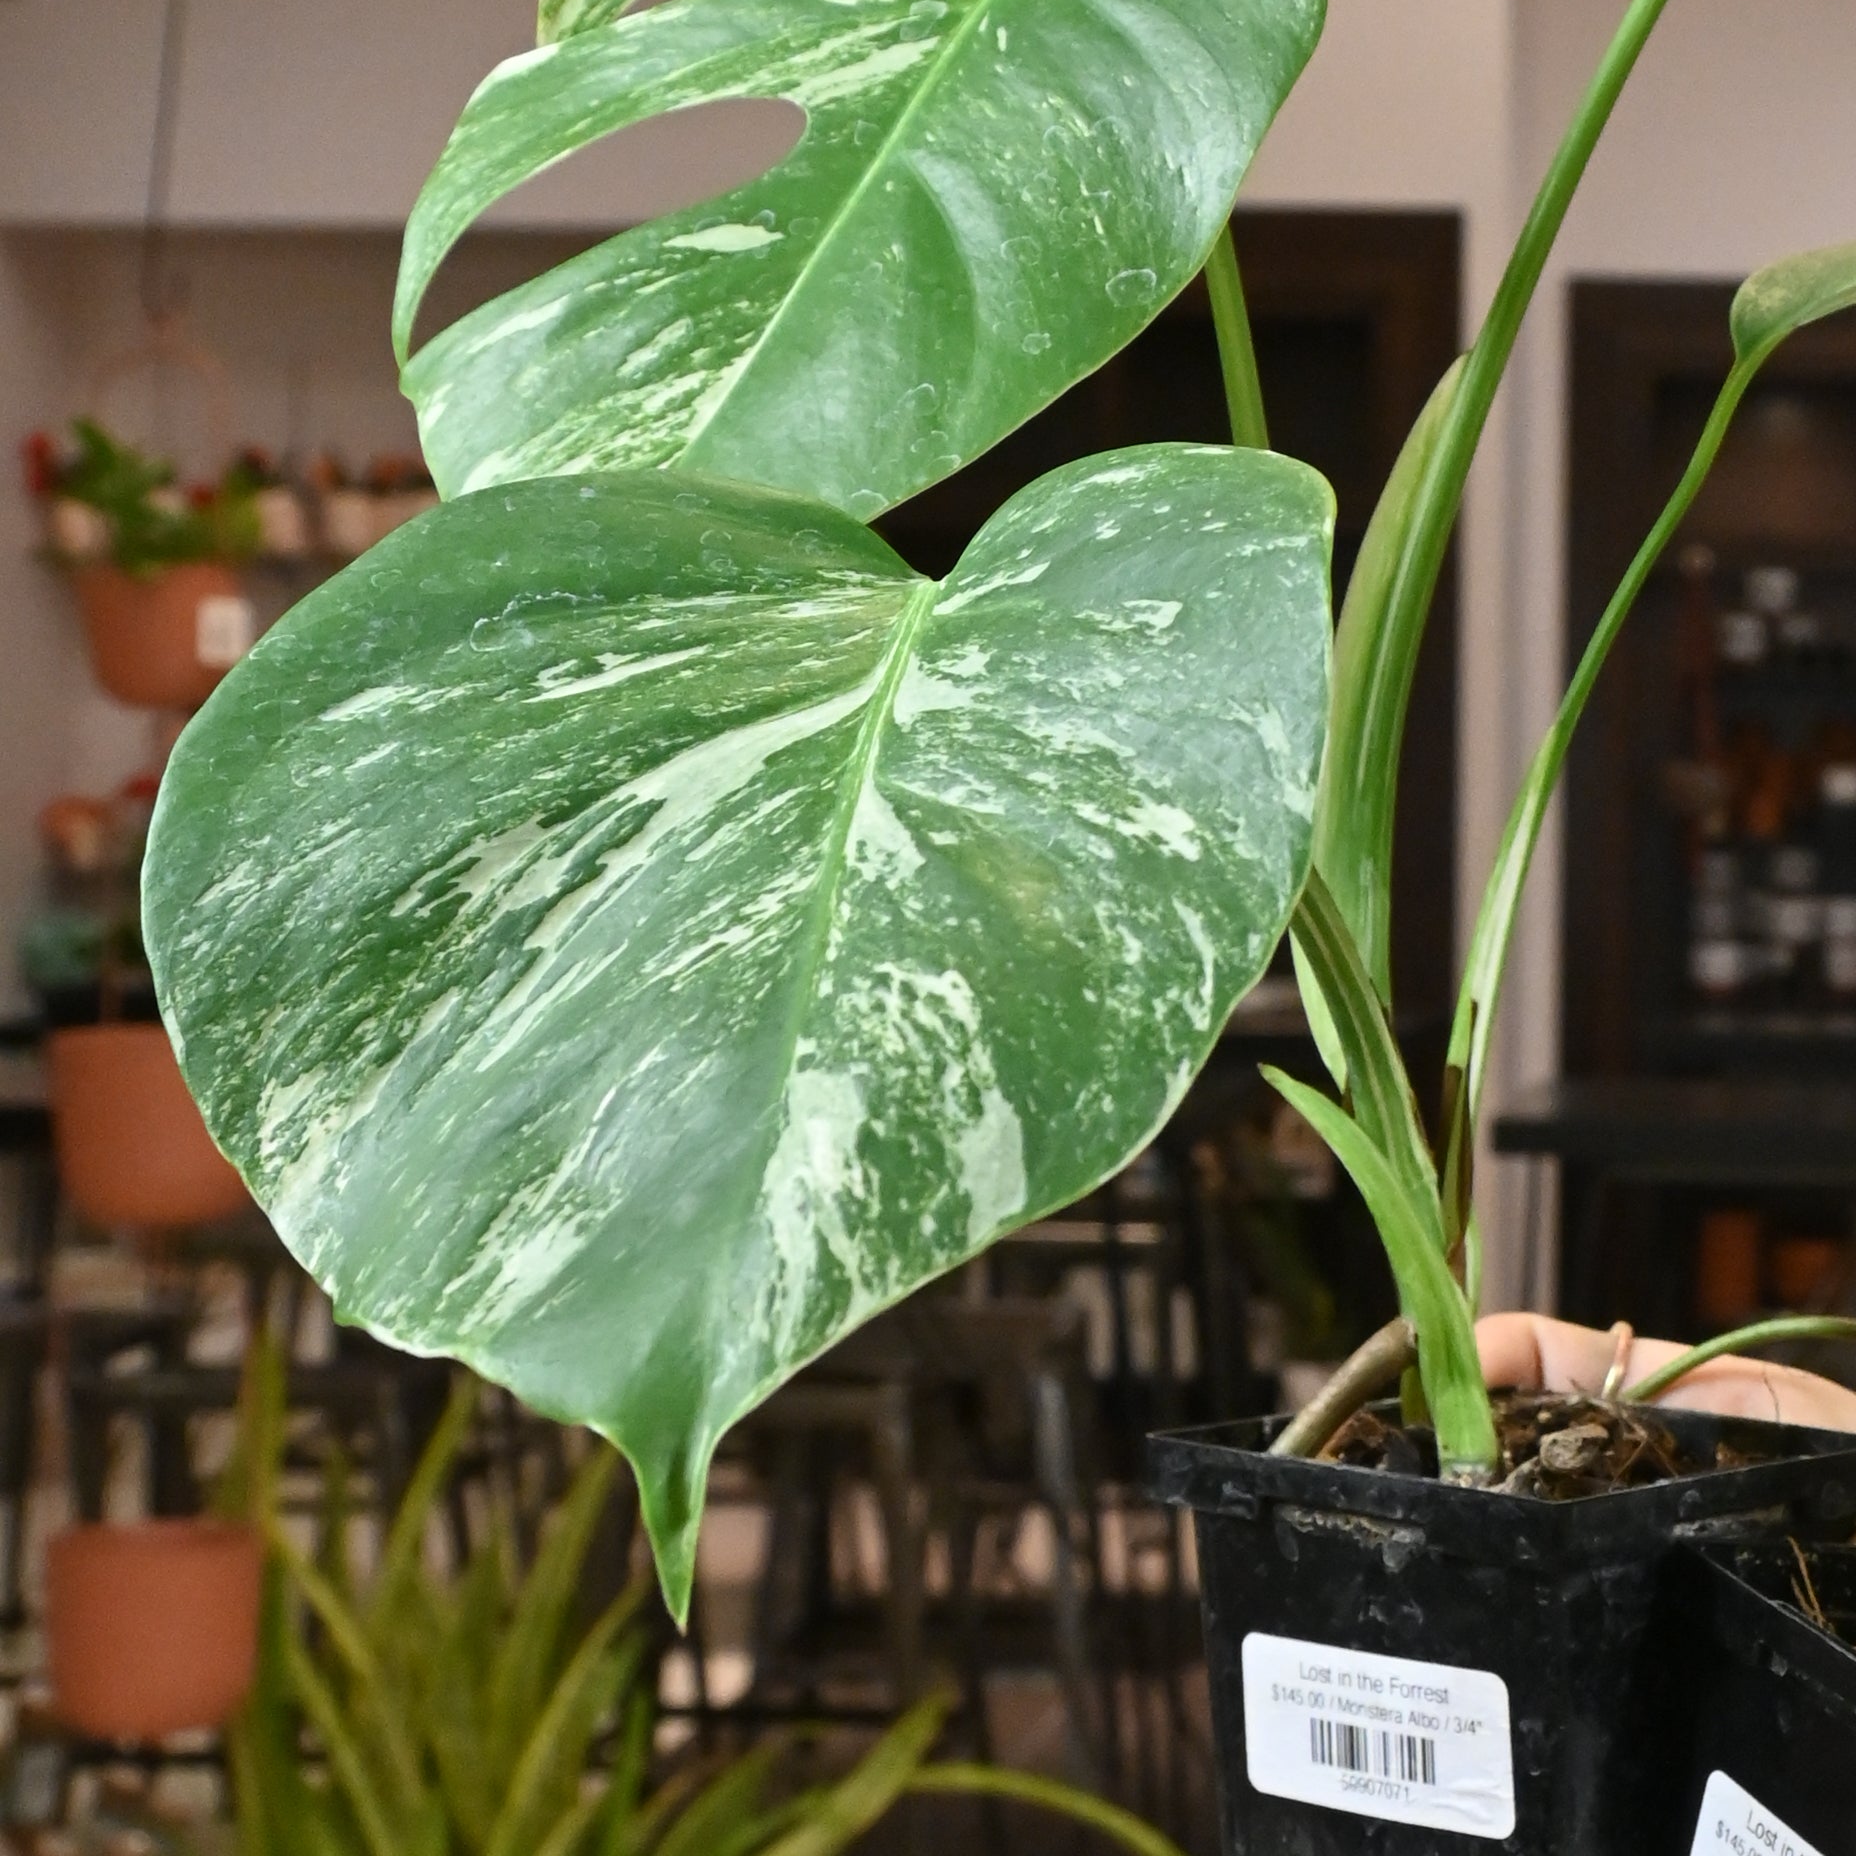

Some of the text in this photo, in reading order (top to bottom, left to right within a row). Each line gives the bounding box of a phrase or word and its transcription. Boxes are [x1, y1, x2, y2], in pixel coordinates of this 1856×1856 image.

[1299, 1662, 1450, 1705] Lost in the Forrest
[1271, 1683, 1324, 1709] $145.00
[1338, 1697, 1403, 1725] Monstera
[1408, 1710, 1440, 1731] Albo
[1746, 1809, 1778, 1850] Lost
